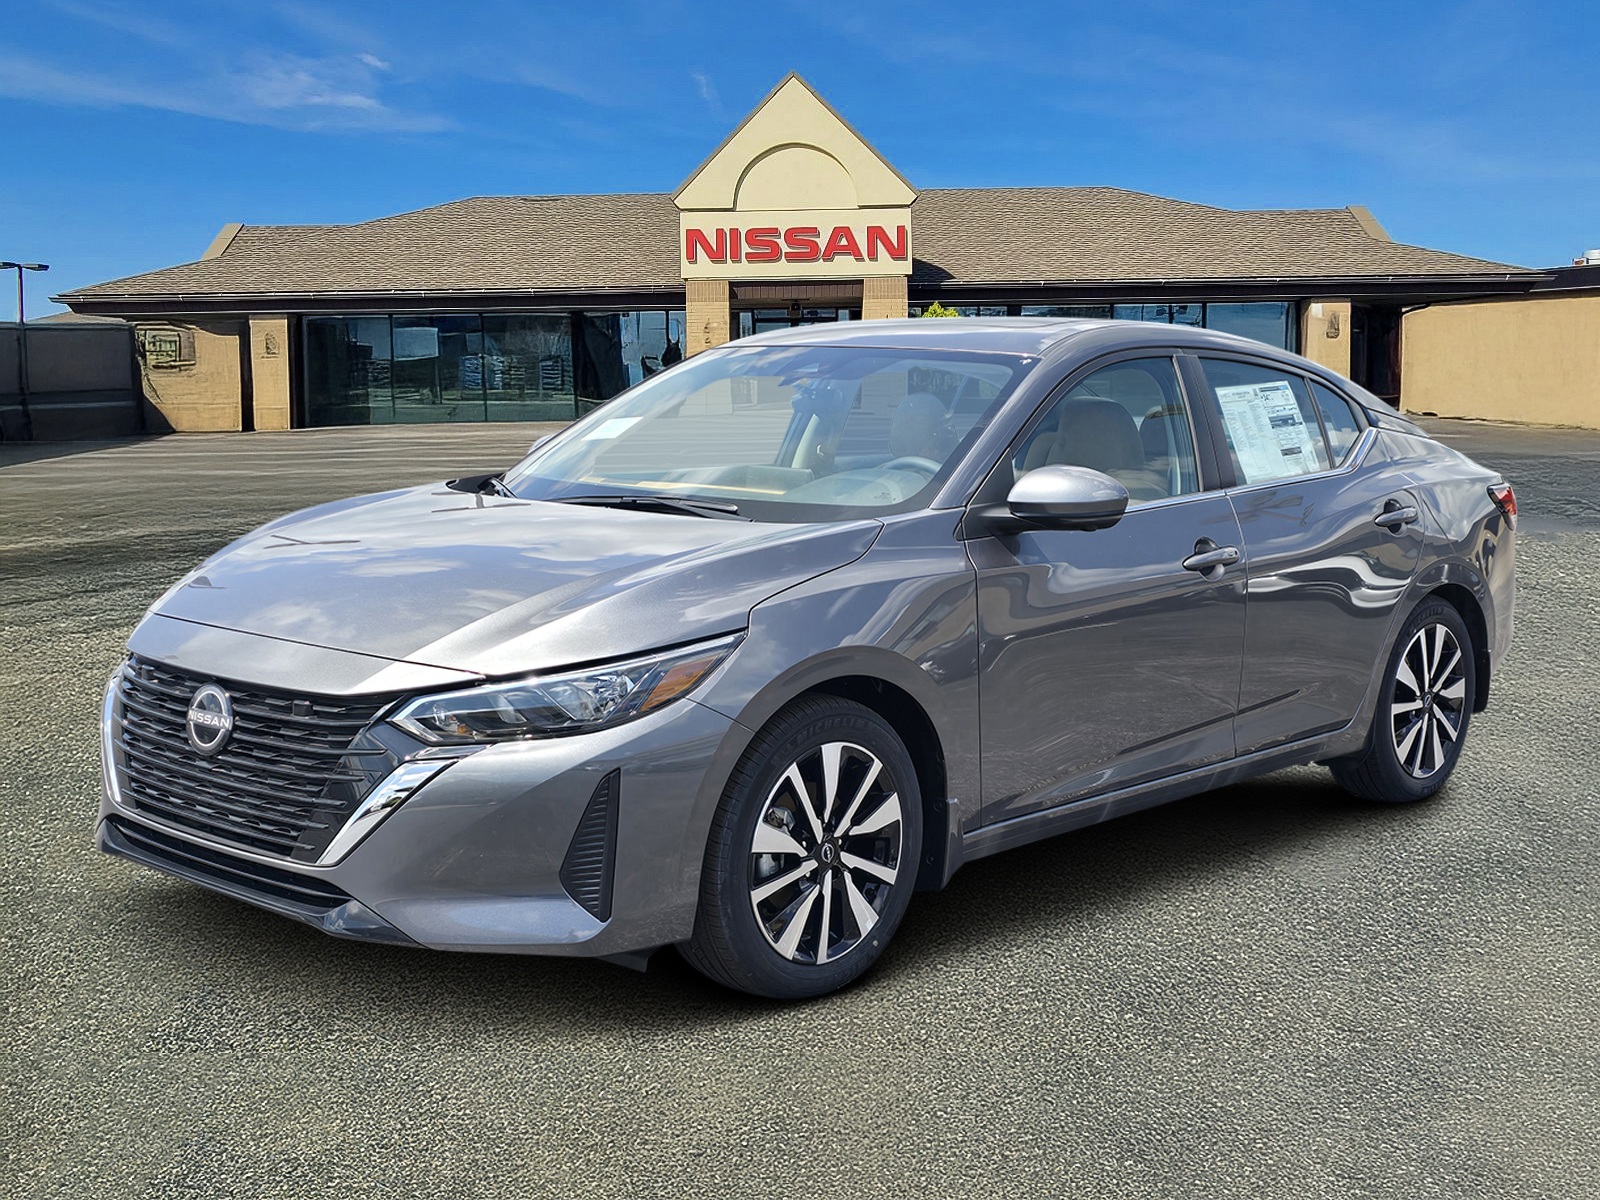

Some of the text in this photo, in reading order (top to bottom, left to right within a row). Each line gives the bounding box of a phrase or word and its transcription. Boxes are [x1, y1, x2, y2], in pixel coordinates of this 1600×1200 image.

[685, 226, 907, 263] NISSAN
[188, 709, 230, 728] NISSAN
[796, 717, 865, 742] MICHELIN
